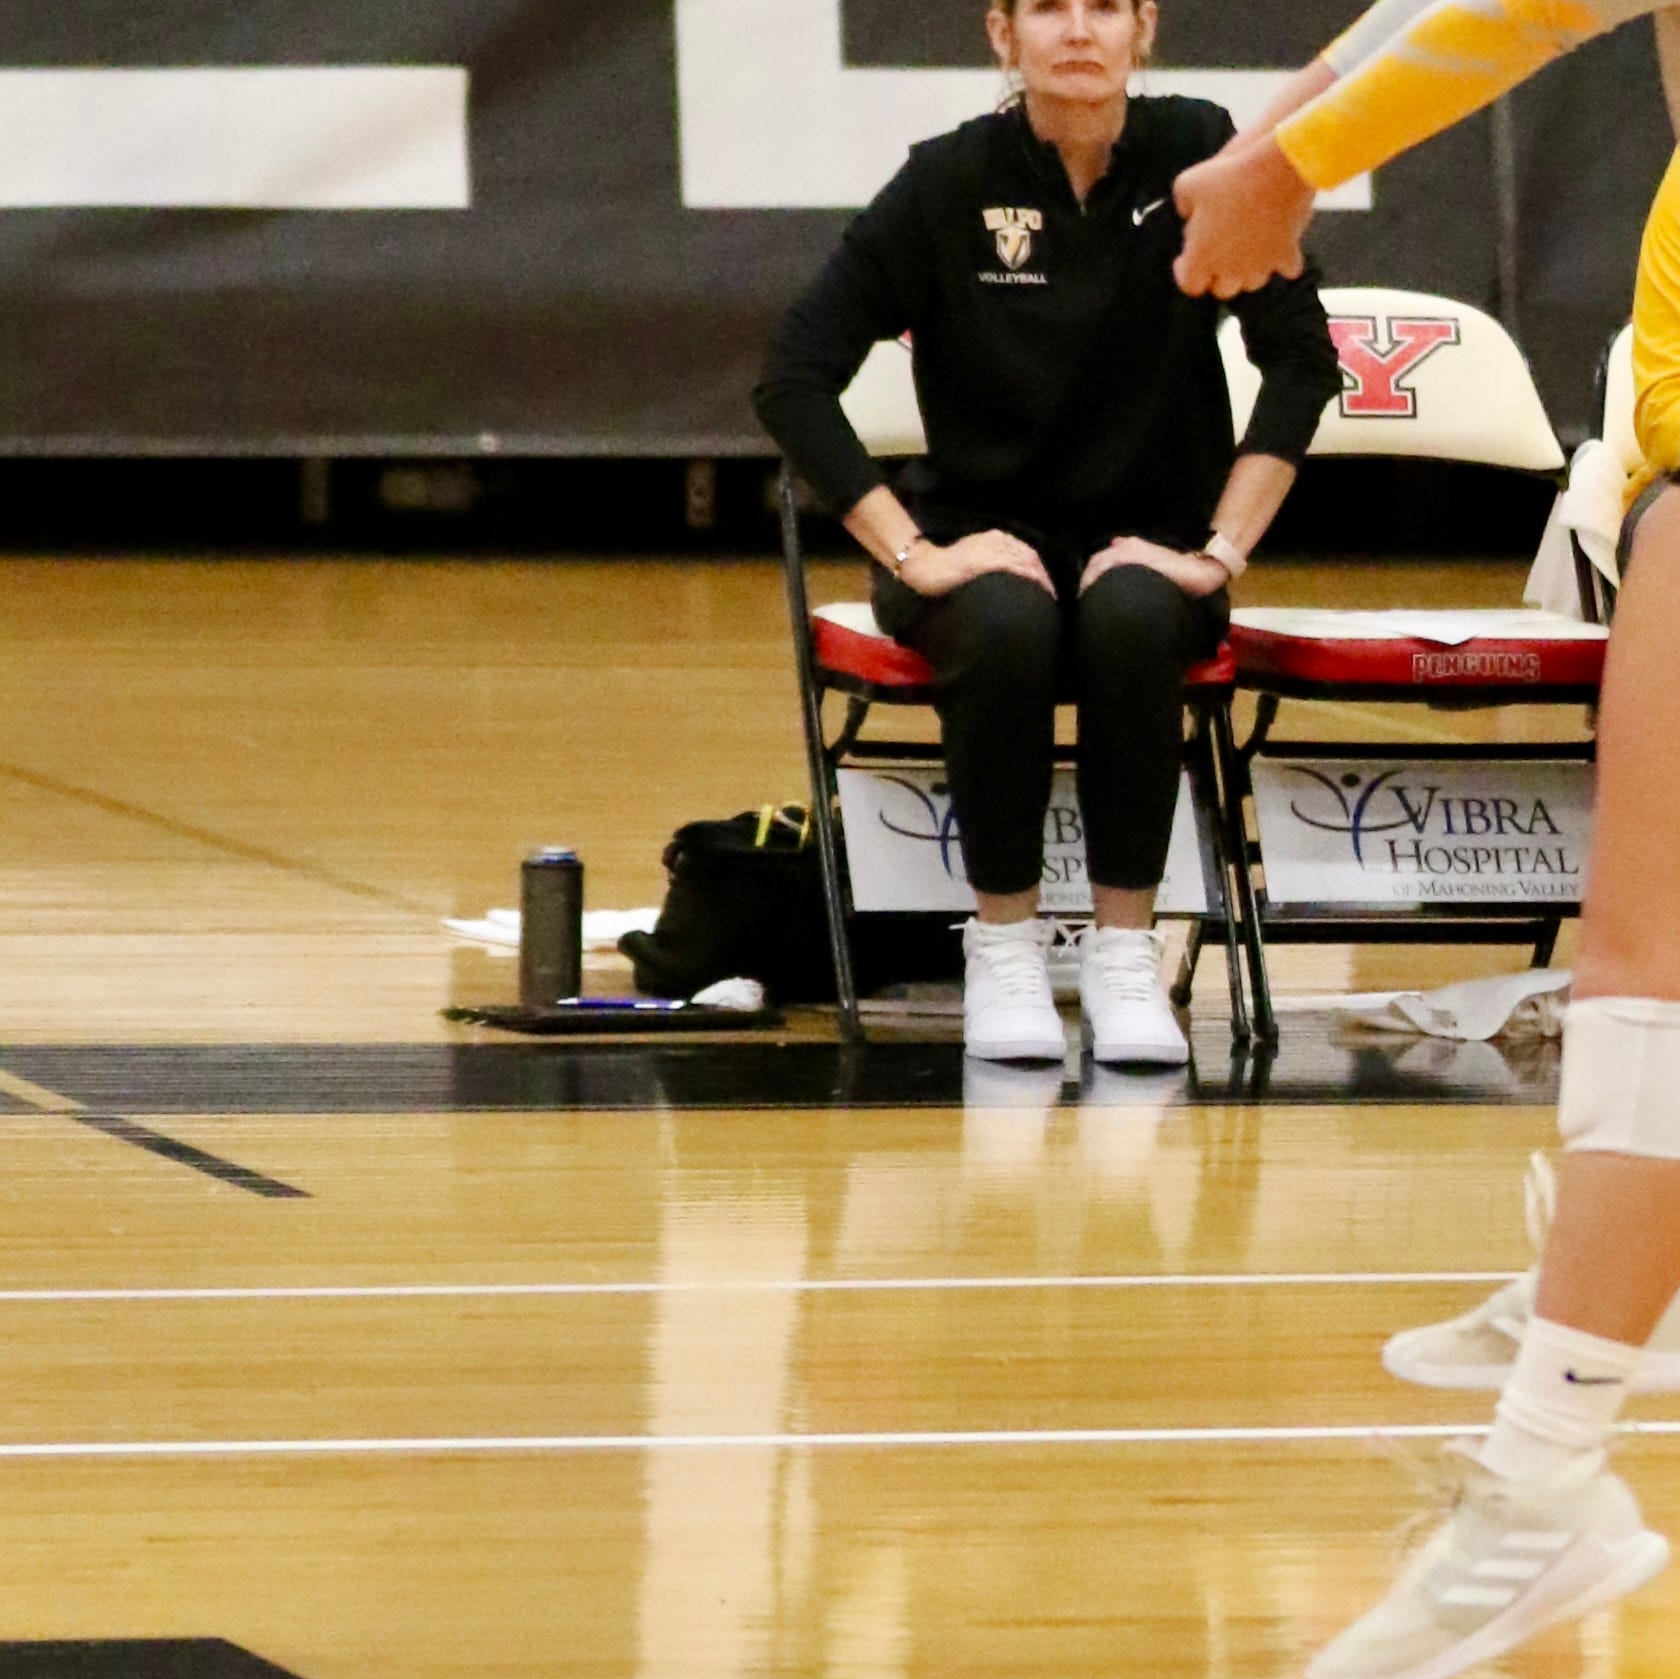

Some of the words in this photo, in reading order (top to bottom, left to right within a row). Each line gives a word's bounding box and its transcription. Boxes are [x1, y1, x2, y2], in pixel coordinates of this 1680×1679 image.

[977, 271, 1048, 285] VOLLEYBALL
[1327, 315, 1461, 418] Y
[1411, 652, 1542, 682] PENGUINS
[1386, 785, 1563, 835] VIBRA
[1385, 839, 1580, 875] HOSPITAL
[1418, 880, 1515, 897] MAHONING
[1517, 880, 1579, 897] VALLEY
